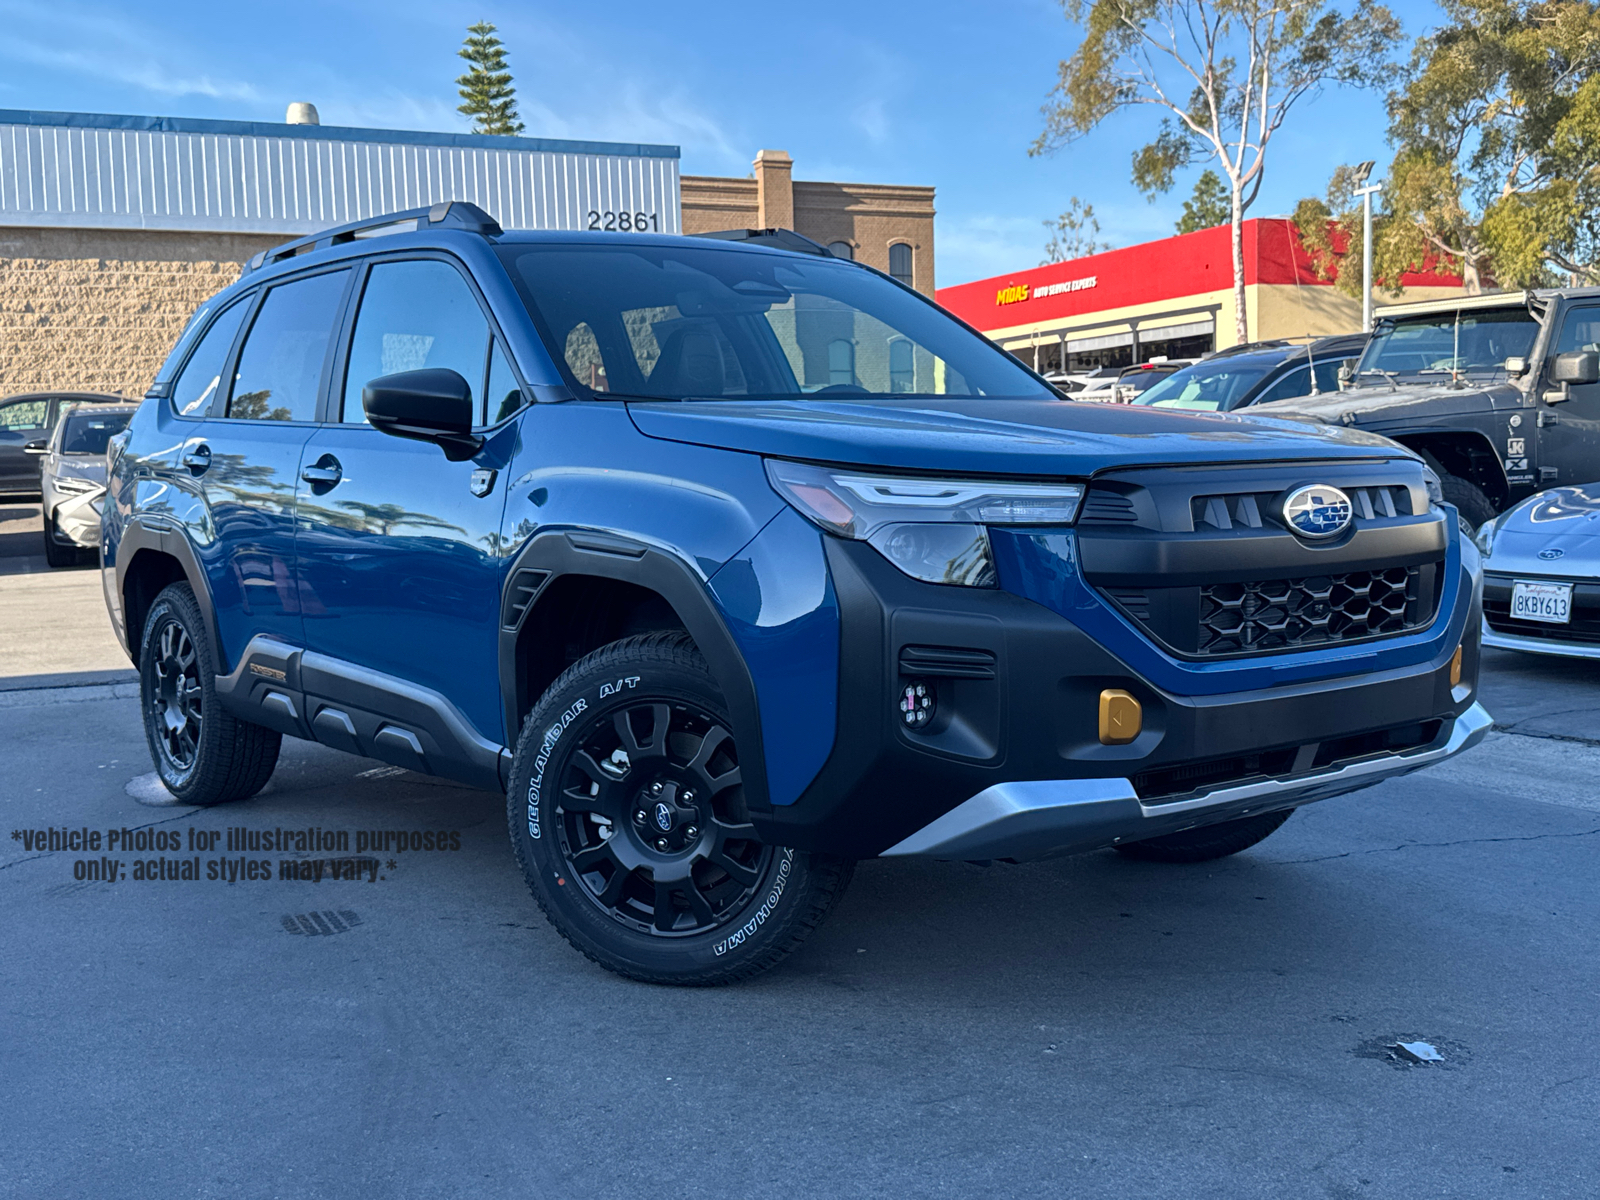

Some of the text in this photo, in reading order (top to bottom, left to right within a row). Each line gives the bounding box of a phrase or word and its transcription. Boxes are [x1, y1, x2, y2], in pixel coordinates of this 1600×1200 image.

[587, 210, 658, 232] 22861
[996, 276, 1097, 305] MIDAS AUTO SERVICE EXPERTS
[1507, 438, 1525, 457] JK
[1517, 595, 1567, 616] 8KBY613
[528, 676, 641, 839] GEOLANDAR A/T
[713, 846, 795, 956] YOKOHAMA
